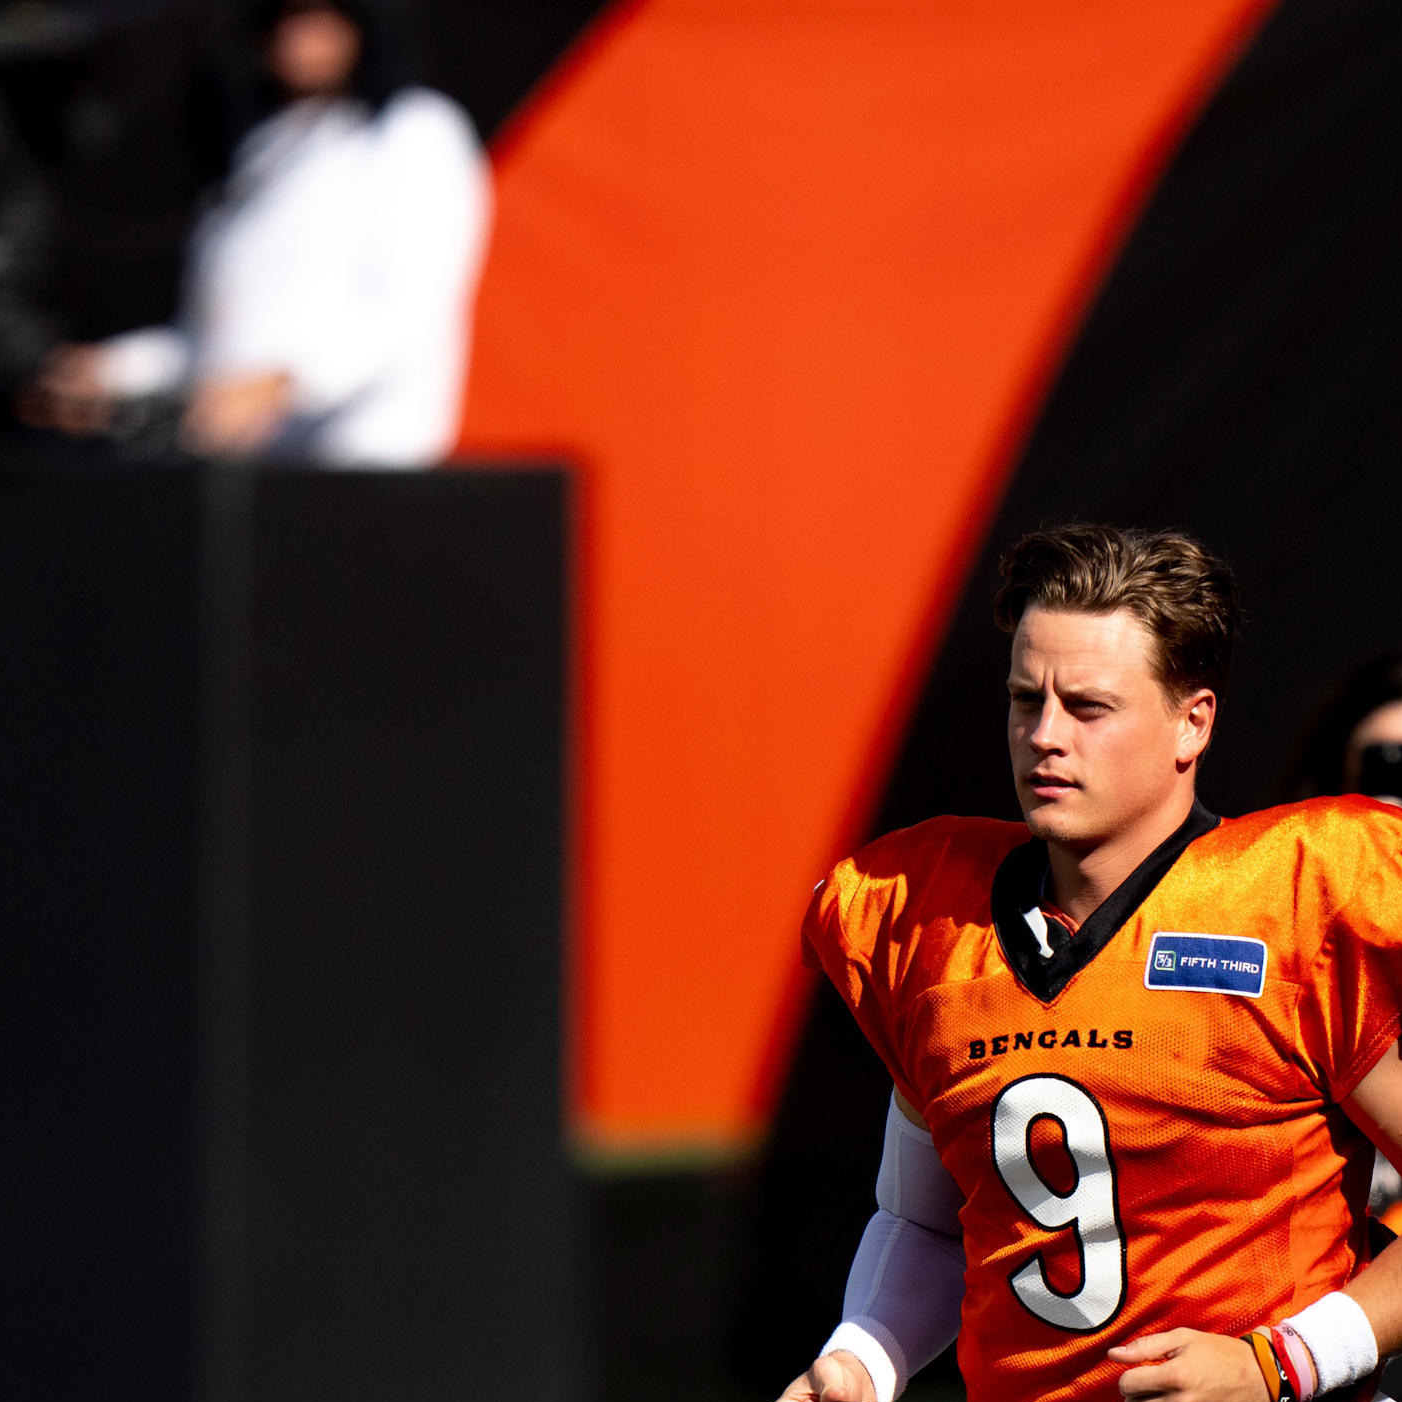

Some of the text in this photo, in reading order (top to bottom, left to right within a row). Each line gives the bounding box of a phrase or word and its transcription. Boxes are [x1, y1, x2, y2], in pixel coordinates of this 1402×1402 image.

[1180, 957, 1260, 974] FIFTH THIRD
[969, 1029, 1133, 1060] BENGALS
[990, 1072, 1128, 1335] 9
